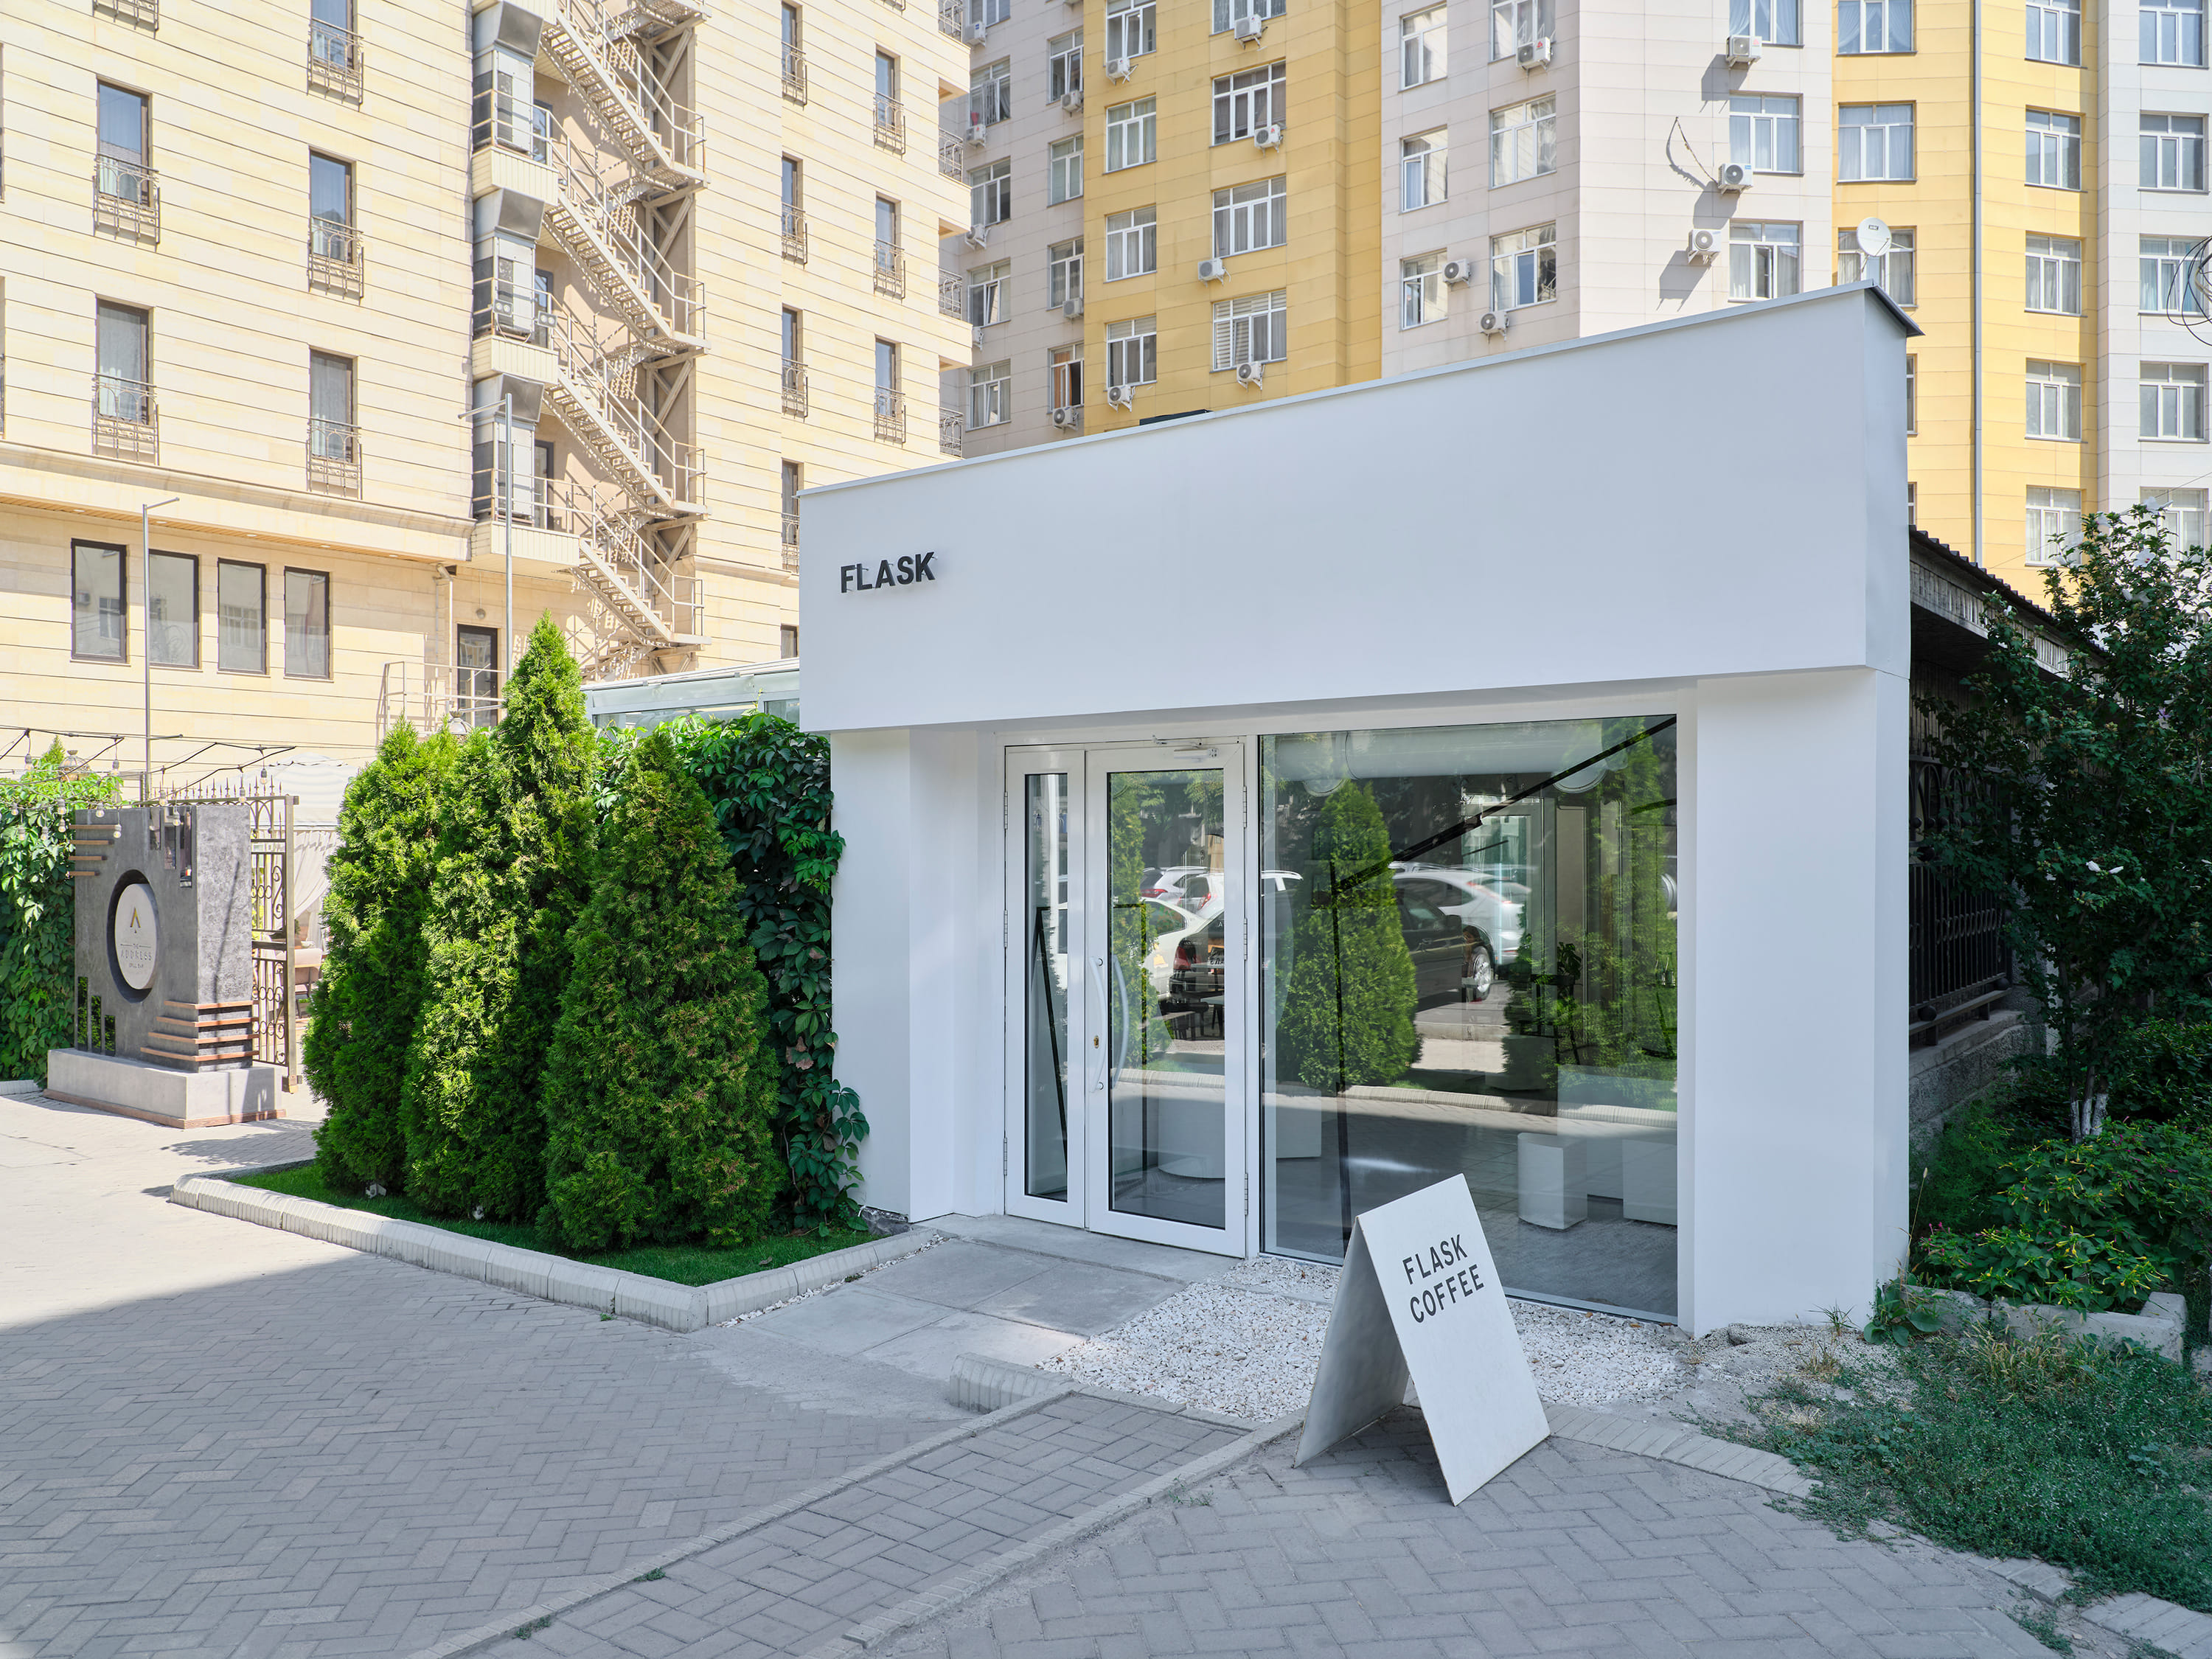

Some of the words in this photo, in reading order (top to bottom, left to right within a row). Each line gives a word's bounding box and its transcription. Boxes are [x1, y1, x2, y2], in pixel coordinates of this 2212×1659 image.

[841, 552, 935, 593] FLASK
[121, 949, 151, 961] ADDRESS
[1402, 1234, 1467, 1284] FLASK
[1410, 1264, 1484, 1323] COFFEE
